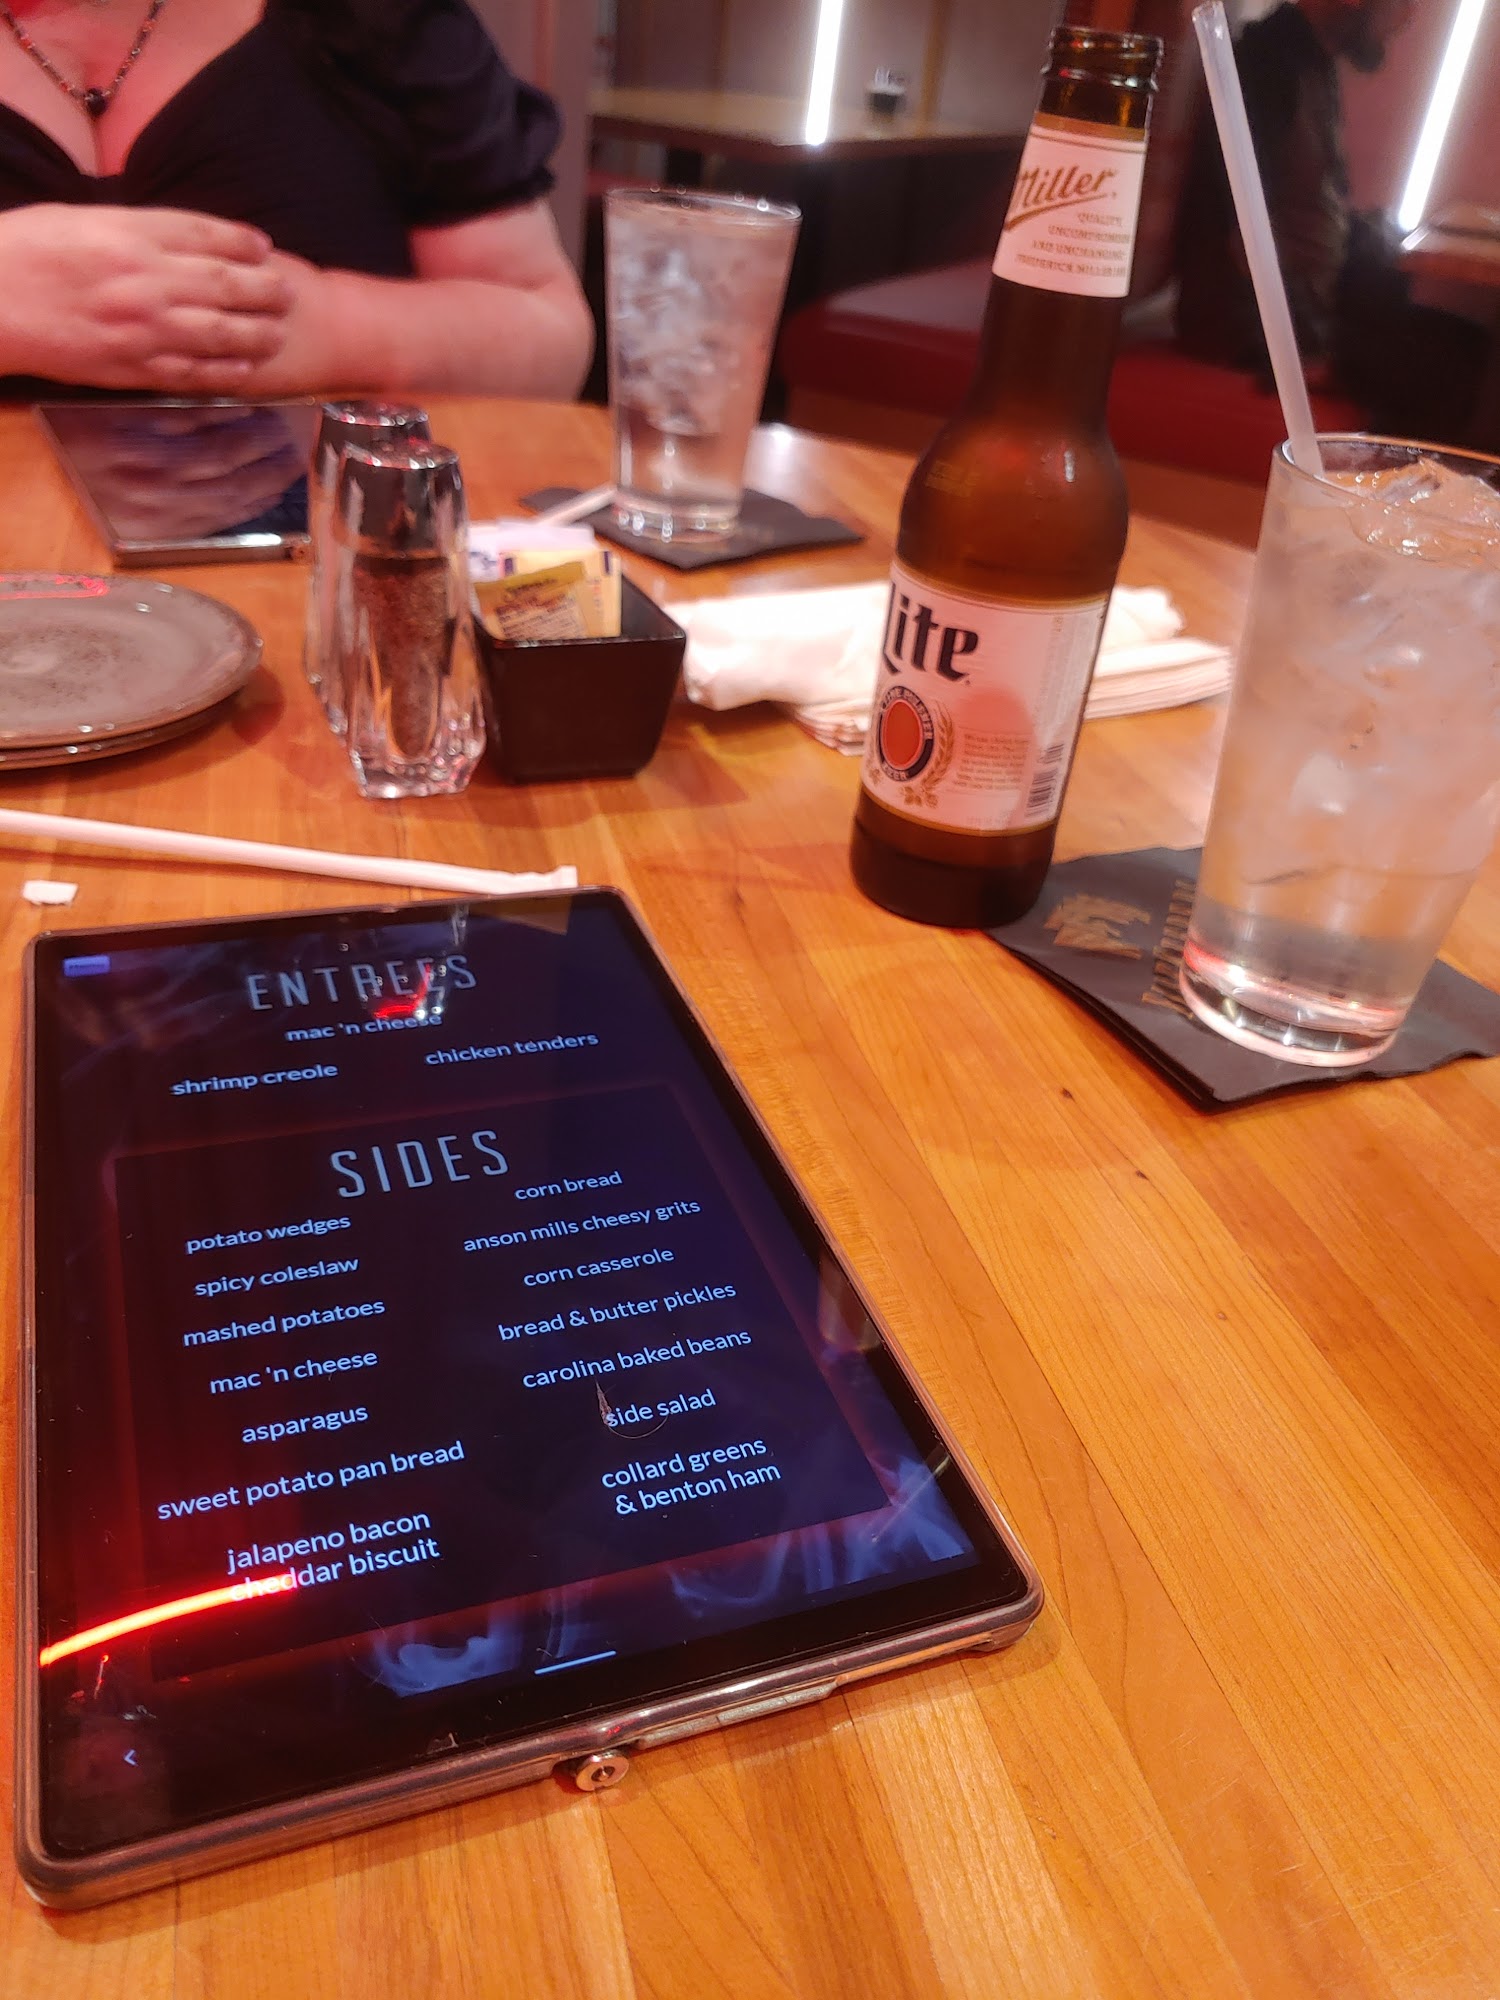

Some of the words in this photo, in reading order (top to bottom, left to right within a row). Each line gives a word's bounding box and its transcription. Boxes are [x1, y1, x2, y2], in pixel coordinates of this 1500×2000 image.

[247, 955, 477, 1011] ENTREES
[285, 1026, 335, 1041] mac
[364, 1014, 442, 1032] cheese
[425, 1044, 511, 1065] chicken
[514, 1034, 599, 1055] tenders
[171, 1075, 258, 1095] shrimp
[261, 1064, 338, 1085] creole
[330, 1130, 508, 1198] SIDES
[515, 1184, 562, 1200] corn
[564, 1171, 623, 1192] bread
[185, 1229, 263, 1255] potato
[265, 1216, 351, 1236] wedges
[464, 1231, 528, 1252] anson
[530, 1221, 580, 1241] mills
[582, 1208, 651, 1231] cheesy
[655, 1200, 701, 1221] grits
[195, 1275, 255, 1297] spicy
[259, 1258, 360, 1286] coleslaw
[523, 1267, 574, 1287] corn
[576, 1248, 675, 1278] casserole
[183, 1316, 277, 1347] mashed
[281, 1300, 386, 1333] potatoes
[498, 1313, 565, 1341] bread
[569, 1309, 589, 1328] &
[590, 1298, 659, 1323] butter
[663, 1284, 737, 1312] pickles
[209, 1372, 262, 1394] mac
[293, 1351, 379, 1379] cheese
[522, 1359, 616, 1388] carolina
[617, 1340, 686, 1369] baked
[686, 1330, 752, 1356] beans
[241, 1406, 369, 1443] asparagus
[605, 1403, 654, 1427] side
[658, 1388, 717, 1416] salad
[157, 1486, 240, 1520] sweet
[246, 1470, 335, 1506] potato
[338, 1460, 388, 1486] pan
[390, 1440, 465, 1472] bread
[601, 1453, 686, 1488] collard
[688, 1438, 767, 1473] greens
[615, 1494, 638, 1515] &
[638, 1475, 728, 1510] benton
[726, 1464, 782, 1490] ham
[226, 1531, 345, 1575] jalapeno
[349, 1512, 431, 1544] bacon
[230, 1560, 343, 1601] cheddar
[348, 1536, 440, 1575] biscuit
